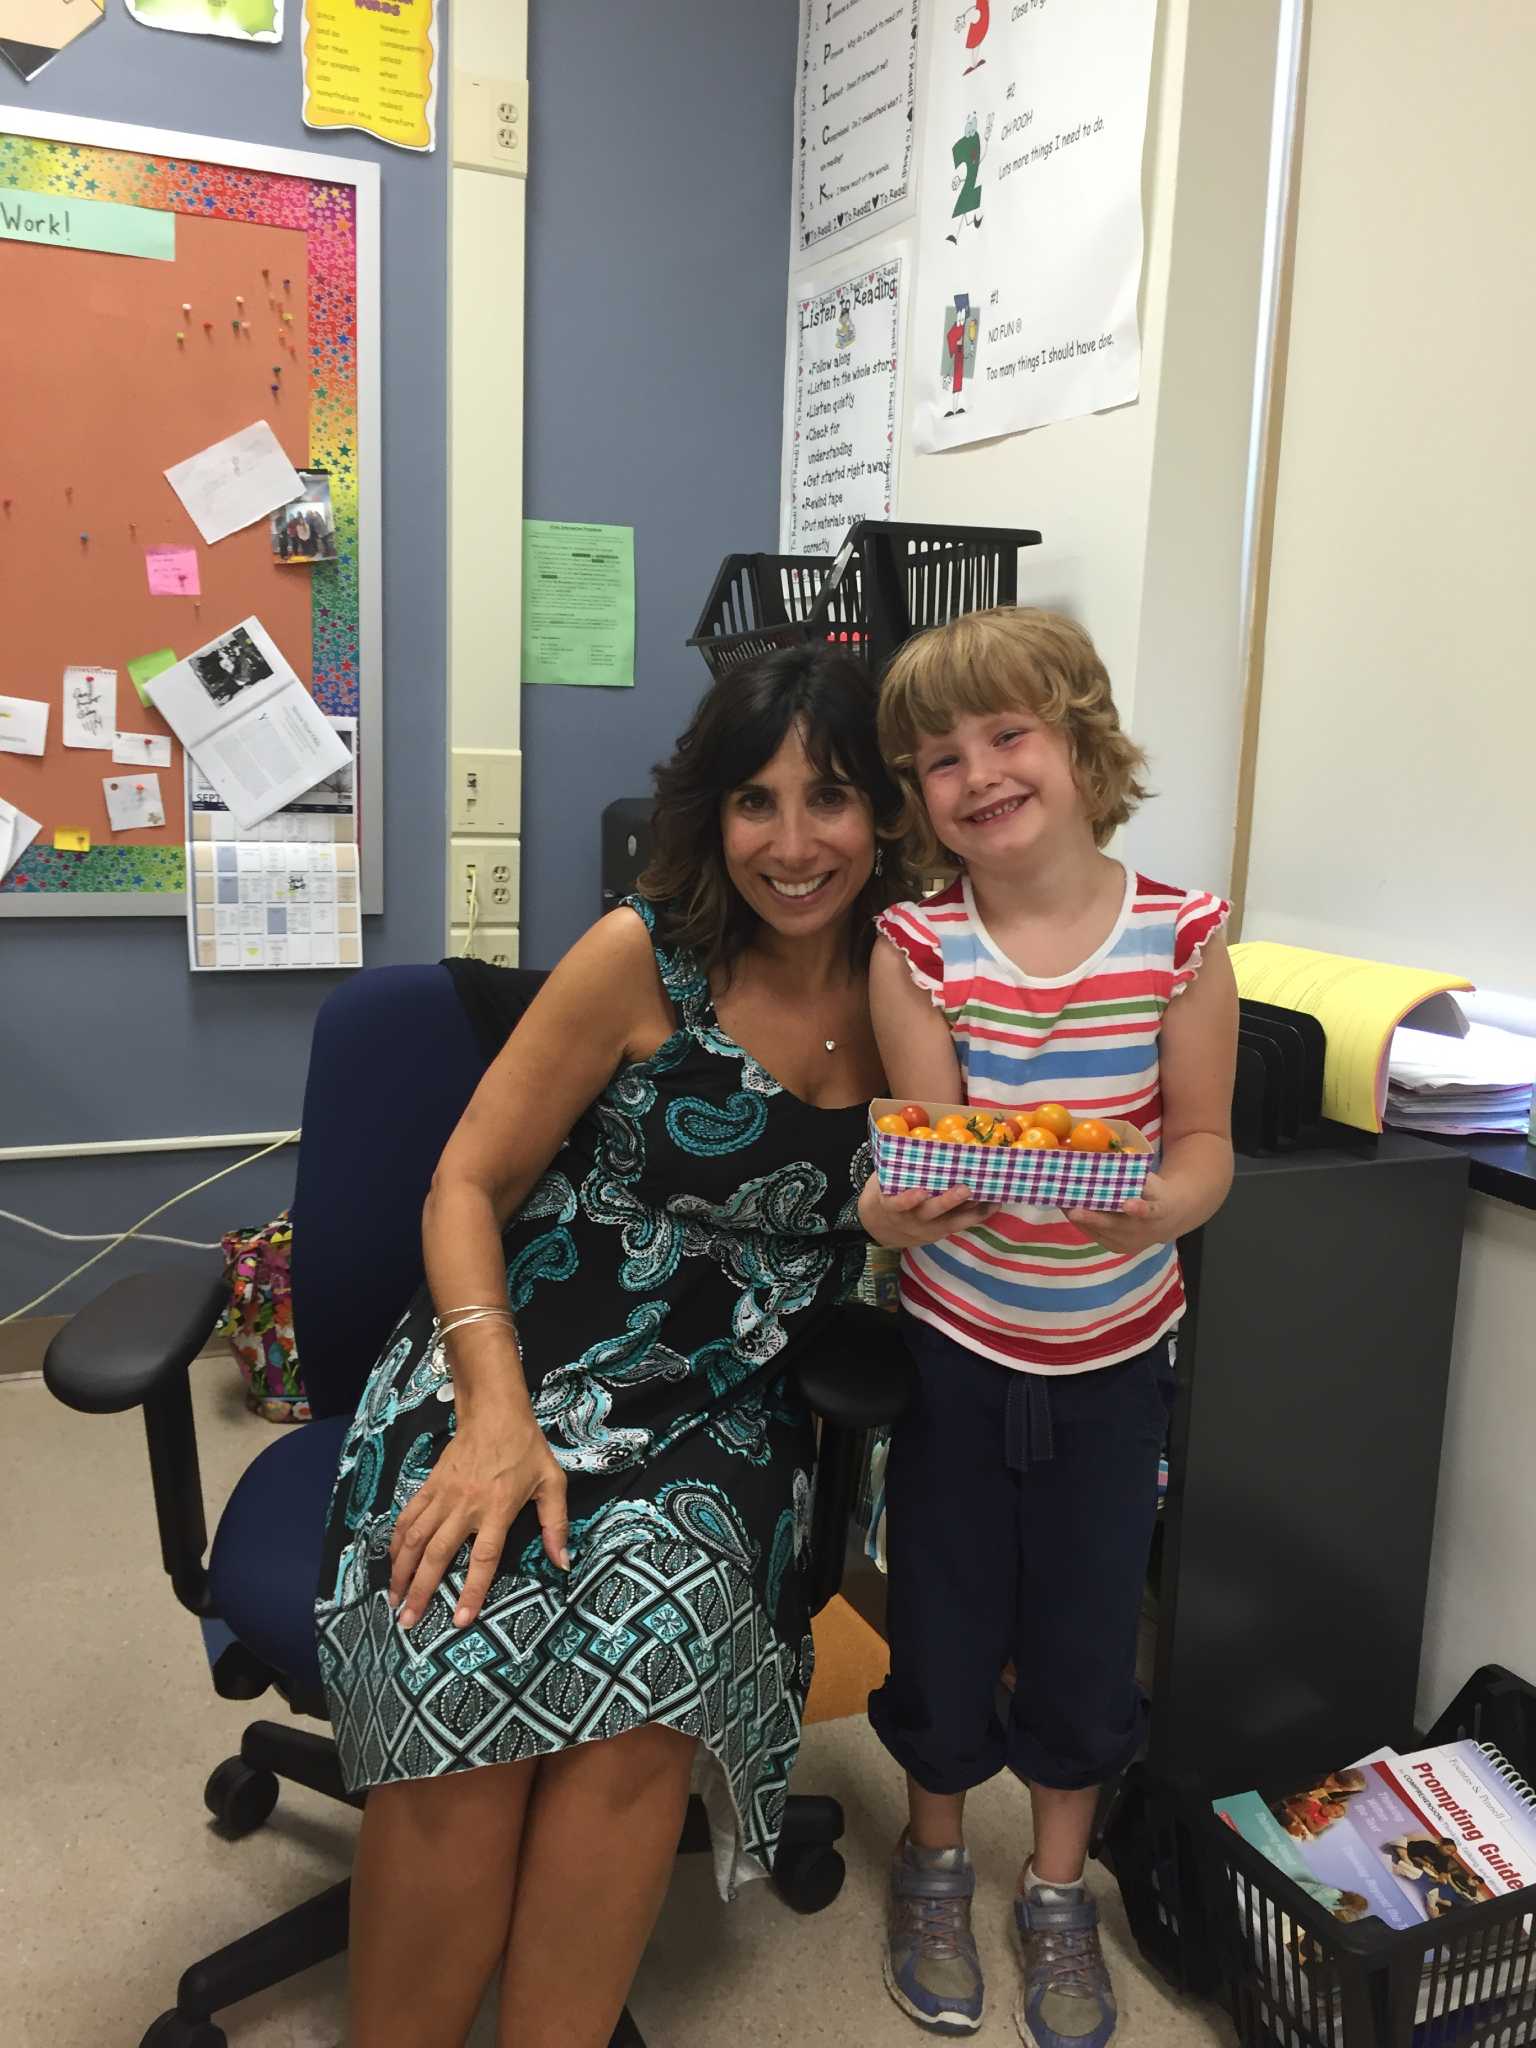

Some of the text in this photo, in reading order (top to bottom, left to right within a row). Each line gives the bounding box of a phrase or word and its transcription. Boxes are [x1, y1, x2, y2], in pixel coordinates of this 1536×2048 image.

[1012, 153, 1030, 172] more
[1030, 140, 1053, 161] things
[1054, 134, 1061, 150] I
[1062, 122, 1081, 148] need
[1082, 122, 1092, 137] to
[1093, 115, 1105, 132] do.
[0, 201, 70, 241] Work!
[800, 277, 898, 330] Listen to Reading
[988, 320, 1015, 344] NO FUN
[812, 352, 851, 376] Follow along
[986, 367, 998, 381] Too
[1000, 362, 1016, 378] many
[1018, 355, 1040, 373] things
[1041, 350, 1046, 365] I
[1048, 341, 1074, 364] should
[1077, 340, 1096, 355] have
[810, 359, 894, 395] Listen to the whole story
[809, 392, 855, 418] Listen quietly
[808, 422, 840, 441] Check for
[808, 442, 852, 464] understanding
[806, 460, 890, 488] Get started right away
[828, 492, 843, 508] tape
[804, 520, 816, 532] Put
[818, 513, 846, 530] materials
[803, 538, 830, 554] correctly
[1412, 1762, 1524, 1890] Prompting Guide
